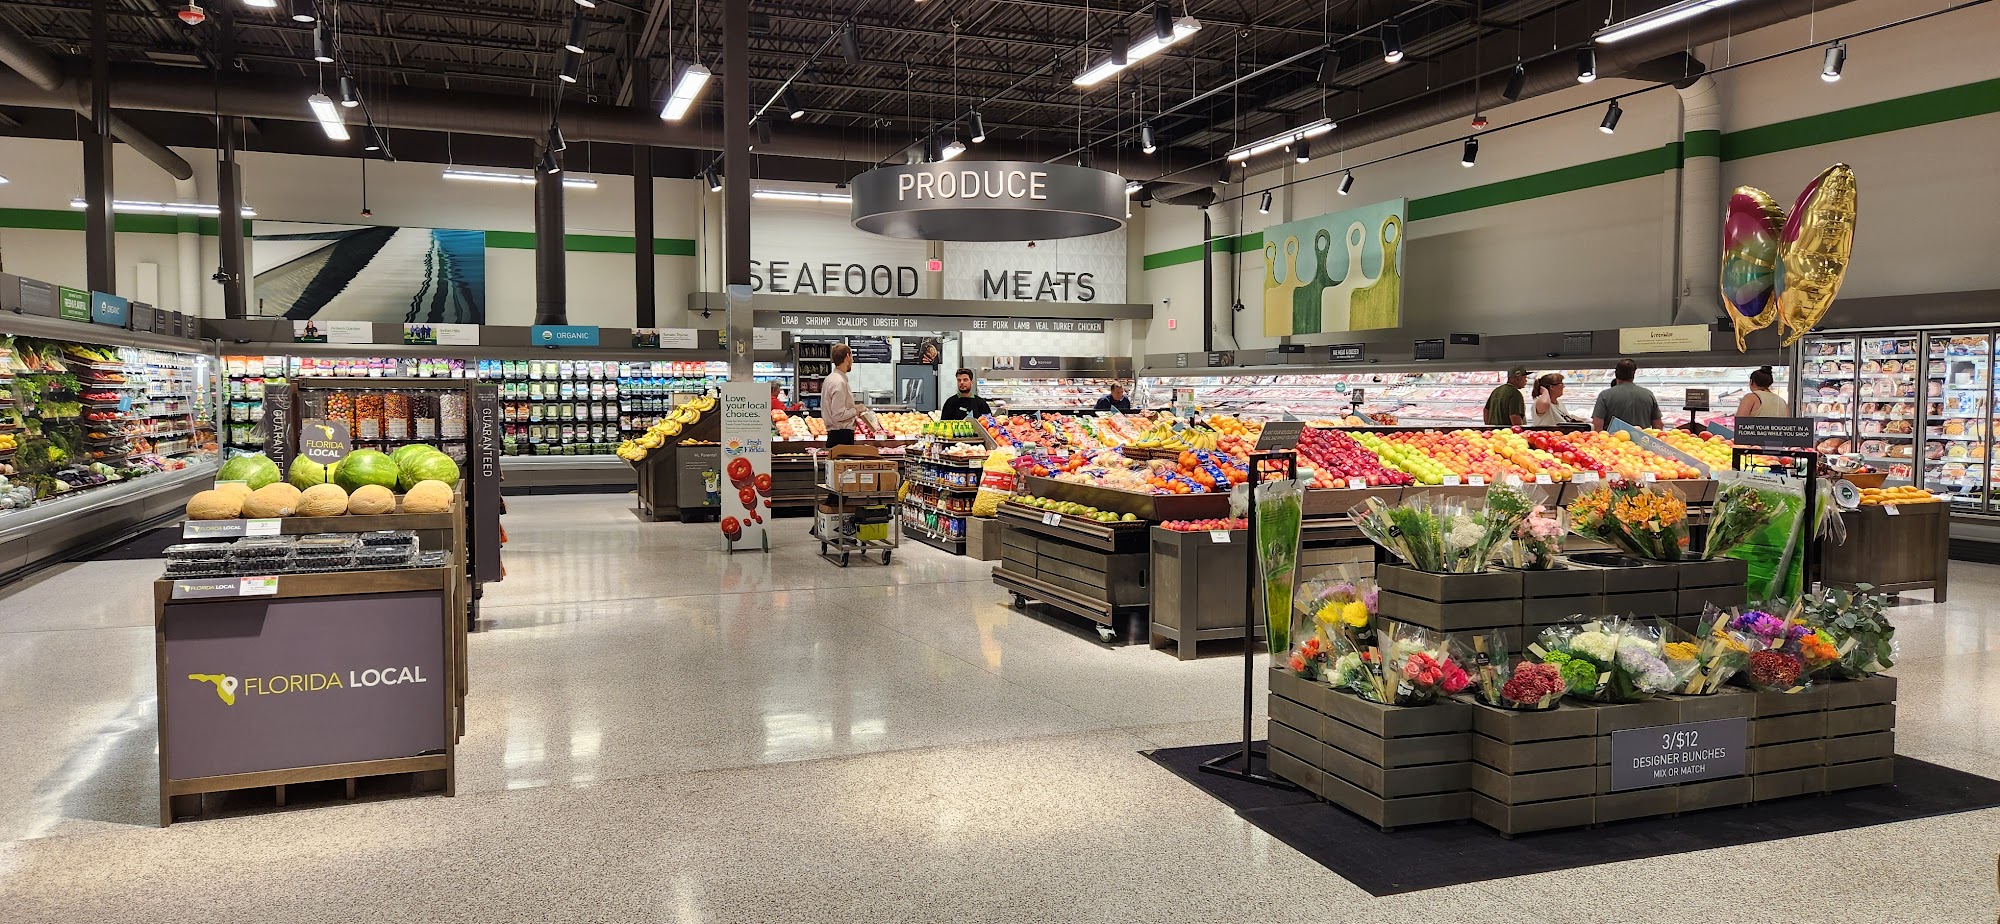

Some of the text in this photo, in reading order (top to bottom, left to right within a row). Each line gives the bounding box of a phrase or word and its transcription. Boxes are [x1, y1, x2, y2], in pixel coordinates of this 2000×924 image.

[898, 170, 1047, 201] PRODUCE
[749, 259, 919, 298] SEAFOOD
[983, 269, 1096, 303] MEATS
[781, 316, 918, 328] CRAB SHRIMP SCALLOPS LOBSTER FISH
[973, 320, 1102, 331] BEEF PORK LAMB VEAL TURKEY CHICKEN
[726, 403, 746, 411] your
[726, 410, 760, 418] choices.
[306, 440, 344, 450] FLORIDA
[482, 408, 493, 477] GUARANTEED
[1652, 440, 1676, 457] ORGANIC
[308, 448, 340, 458] LOCAL
[244, 666, 427, 696] FLORIDA LOCAL
[1662, 730, 1698, 750] 3/$12
[1633, 748, 1726, 769] DESIGNER BUNCHES
[1653, 764, 1706, 778] MIX OR MATCH
